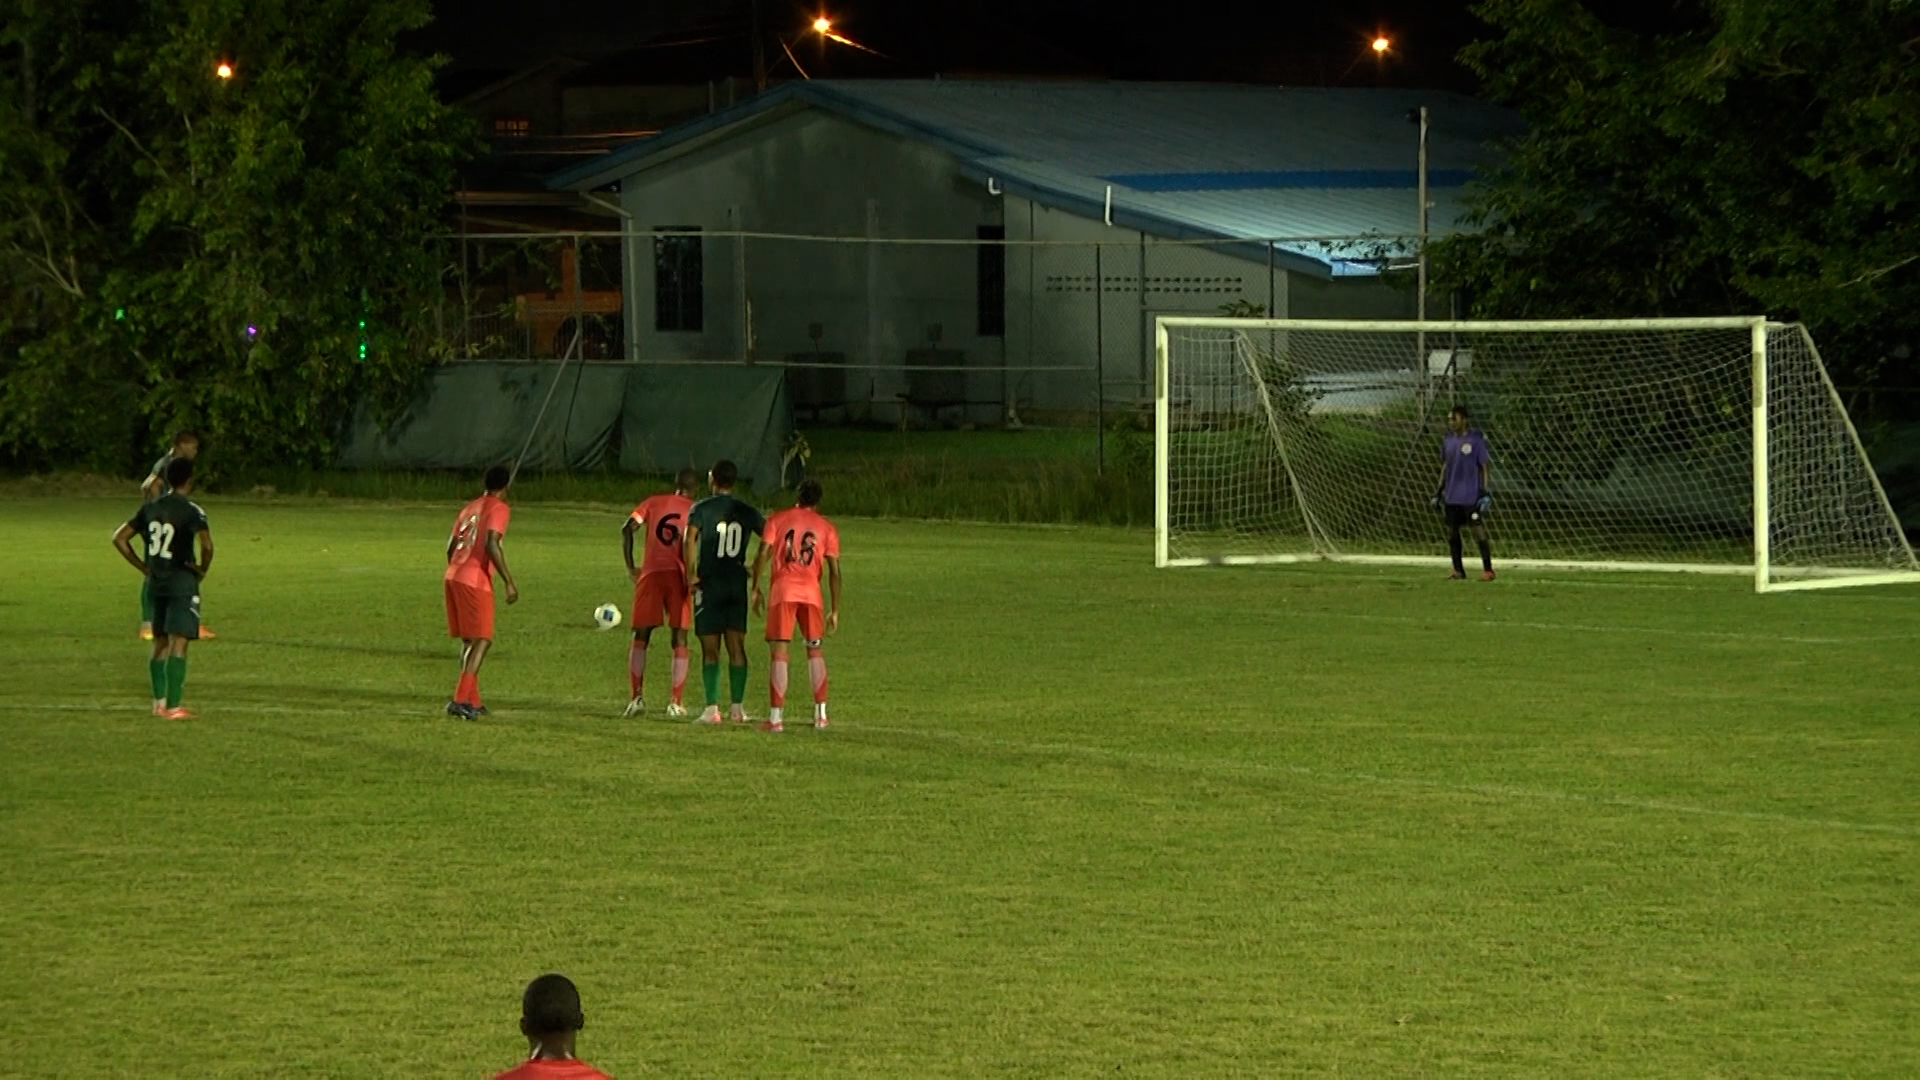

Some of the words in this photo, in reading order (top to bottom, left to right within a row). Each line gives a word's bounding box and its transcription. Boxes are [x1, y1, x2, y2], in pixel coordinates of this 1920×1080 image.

[148, 520, 175, 560] 32
[656, 513, 681, 546] 6
[716, 521, 742, 558] 10
